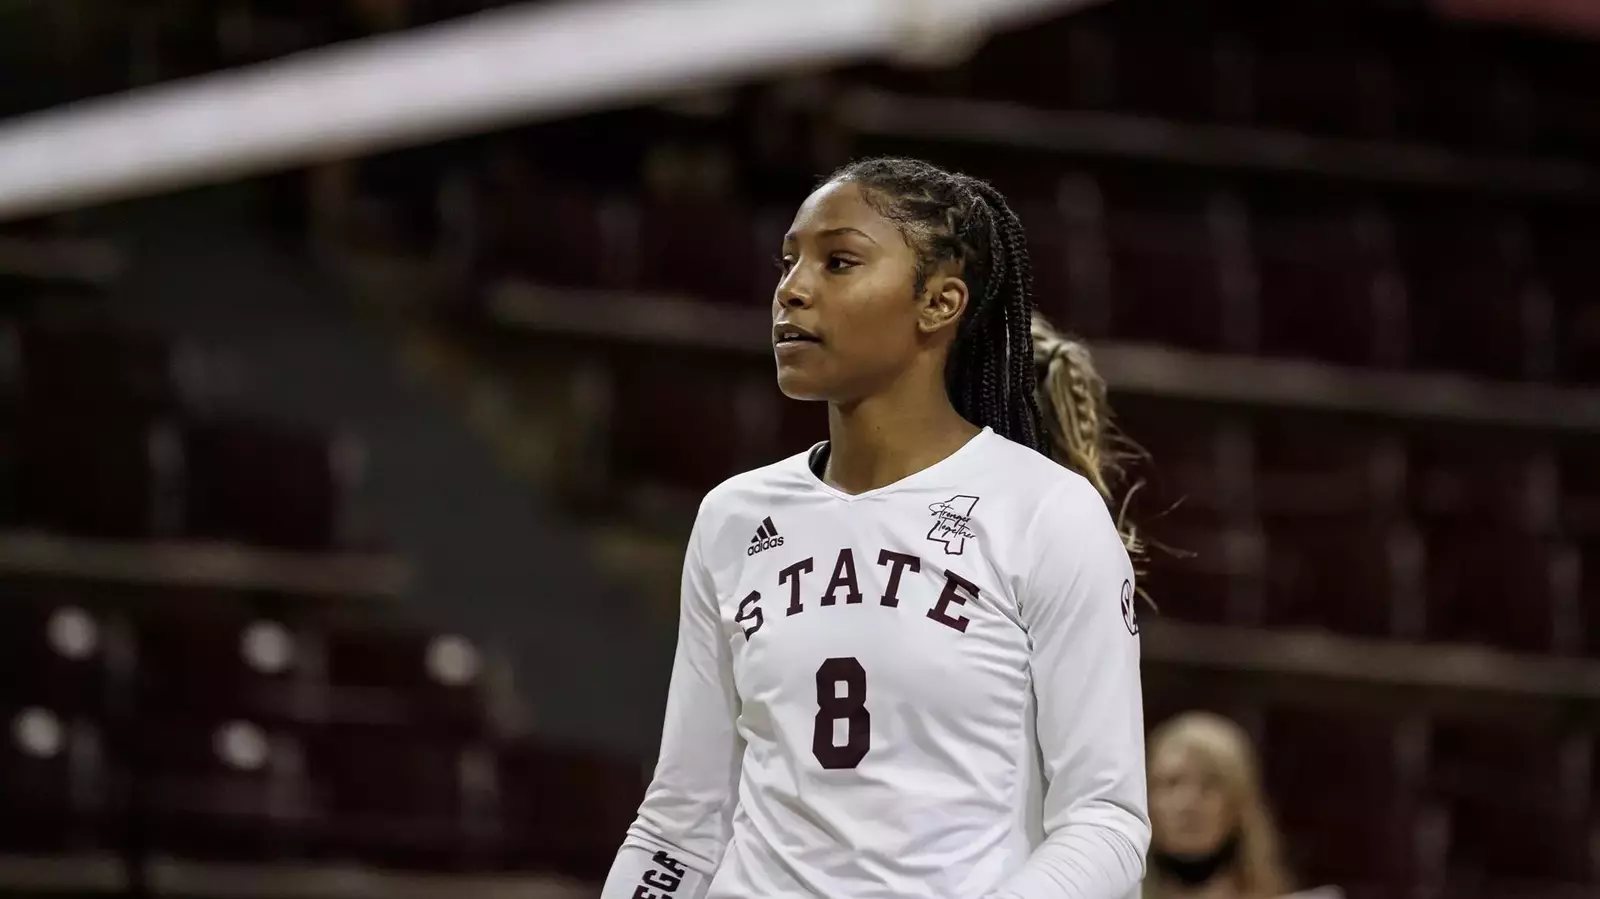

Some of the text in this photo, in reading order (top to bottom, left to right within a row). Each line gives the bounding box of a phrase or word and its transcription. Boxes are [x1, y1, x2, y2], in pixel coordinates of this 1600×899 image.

[928, 502, 972, 527] Stronger
[937, 517, 976, 539] Together
[747, 535, 784, 556] adidas
[734, 548, 981, 641] STATE
[812, 657, 871, 769] 8
